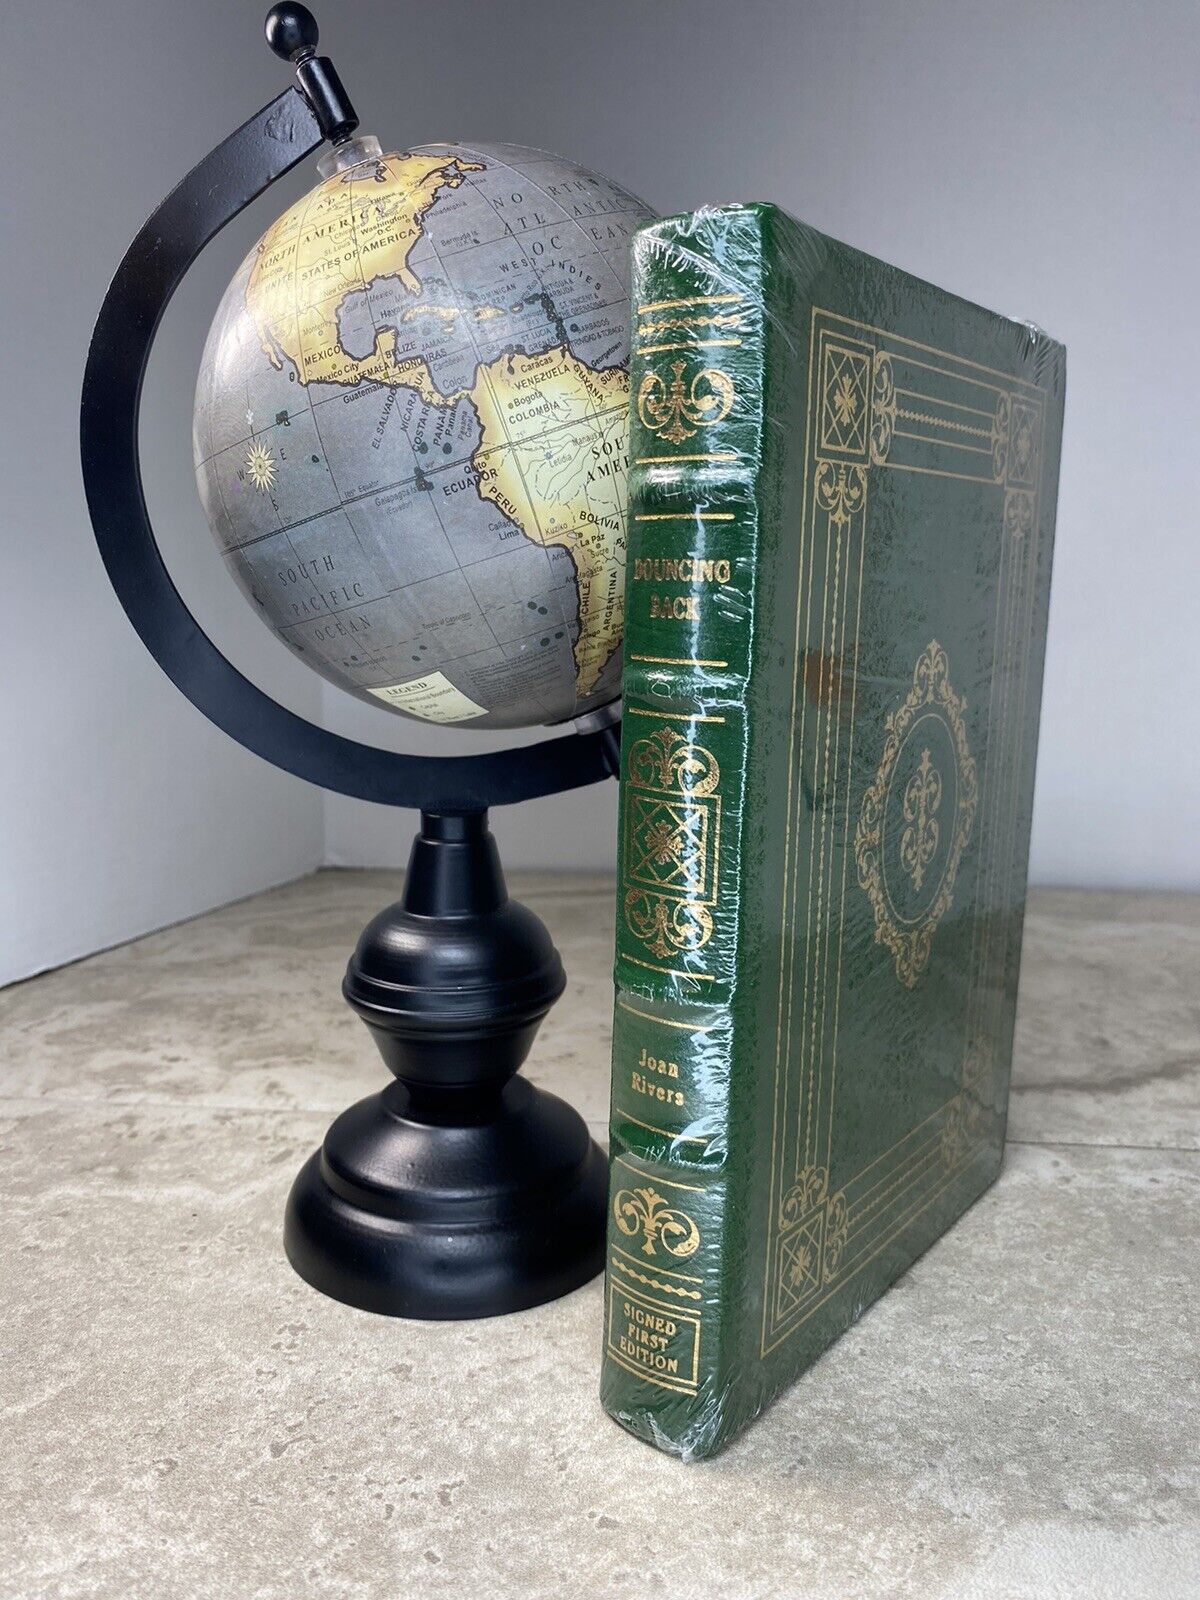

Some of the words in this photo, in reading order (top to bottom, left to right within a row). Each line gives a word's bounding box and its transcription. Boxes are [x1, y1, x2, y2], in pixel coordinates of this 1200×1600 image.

[425, 201, 468, 219] Philadelphia
[303, 205, 385, 247] AMERICA
[360, 214, 408, 235] Washington
[376, 225, 394, 236] D.C.
[301, 257, 341, 281] STATES
[343, 249, 360, 262] OF
[362, 229, 417, 254] AMERICA
[499, 257, 537, 273] WEST
[551, 259, 602, 291] INDIES
[324, 287, 335, 297] New
[345, 302, 359, 314] Gulf
[360, 298, 368, 307] of
[369, 289, 394, 303] Mexico
[476, 284, 517, 302] DOMINICAN
[532, 328, 551, 341] LUCIA
[602, 325, 625, 339] TOBAGO
[304, 345, 341, 366] MEXICO
[385, 341, 417, 359] BELIZE
[398, 348, 447, 373] HONDURAS
[591, 341, 623, 368] Georgetown
[316, 369, 343, 382] Mexico
[343, 362, 360, 374] City
[343, 362, 391, 385] GUATEMALA
[520, 356, 553, 373] Caracas
[443, 375, 468, 390] Colon
[514, 364, 571, 391] VENEZUELA
[573, 363, 605, 402] GUYANA
[343, 383, 384, 405] Guatemala
[514, 390, 543, 408] Bogota
[507, 400, 561, 425] COLOMBIA
[372, 437, 381, 451] EL
[411, 415, 430, 453] COSTA
[571, 432, 600, 447] Manaus
[280, 448, 287, 461] E
[592, 433, 630, 461] SOU
[464, 461, 487, 474] Qito
[358, 479, 380, 493] Equator
[443, 467, 499, 496] ECUADOR
[375, 488, 411, 507] Galapagos
[488, 485, 517, 516] PERU
[580, 510, 620, 531] BOLIVIA
[498, 530, 520, 541] Lima
[580, 539, 590, 548] La
[591, 533, 606, 545] Paz
[590, 546, 610, 559] Sucre
[278, 554, 336, 588] SOUTH
[633, 557, 731, 584] BOUNCING
[291, 582, 366, 617] PACIFIC
[581, 580, 591, 615] CHILE
[603, 570, 618, 632] ARGENTINA
[650, 594, 702, 620] BACK
[314, 614, 374, 642] OCEAN
[386, 681, 428, 696] LEGEND
[638, 1048, 680, 1079] Joan
[631, 1071, 685, 1107] Rivers
[623, 1302, 677, 1337] SIGNED
[627, 1322, 669, 1352] FIRST
[619, 1335, 679, 1374] EDITION
